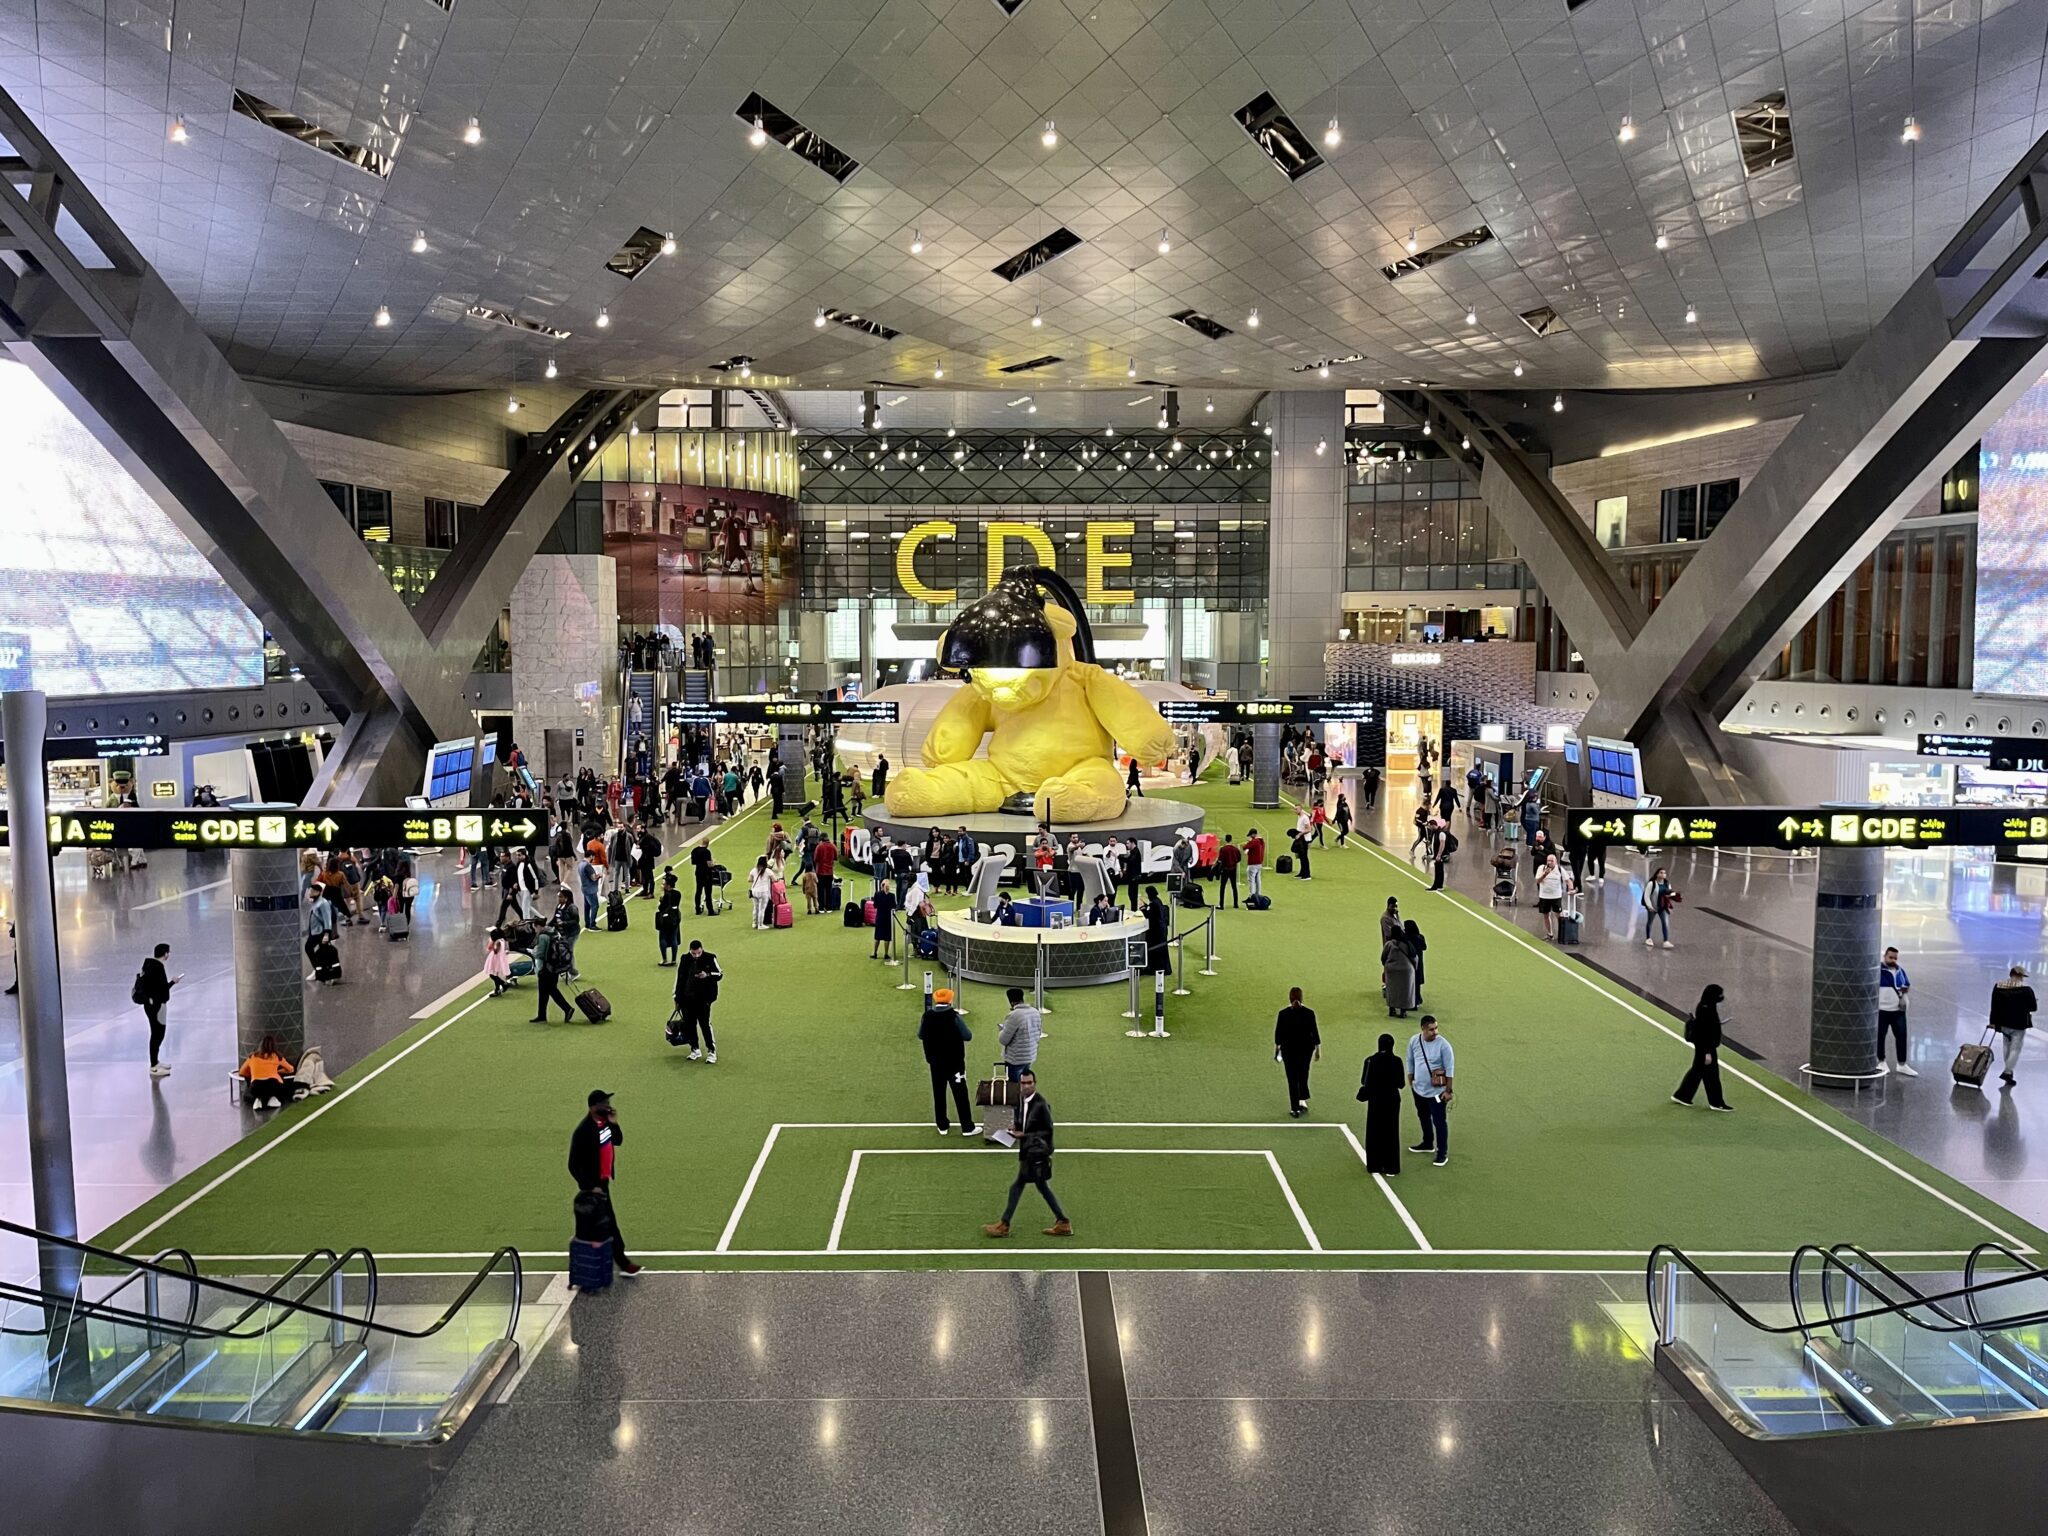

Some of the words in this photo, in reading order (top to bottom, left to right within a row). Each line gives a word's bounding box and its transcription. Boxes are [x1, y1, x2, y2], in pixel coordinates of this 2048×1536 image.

[775, 704, 799, 715] CDE
[1259, 704, 1282, 714] CDE
[66, 819, 86, 841] A
[200, 819, 255, 841] CDE
[433, 818, 452, 840] B
[1664, 817, 1686, 839] A
[1862, 817, 1916, 839] CDE
[2030, 816, 2047, 838] B
